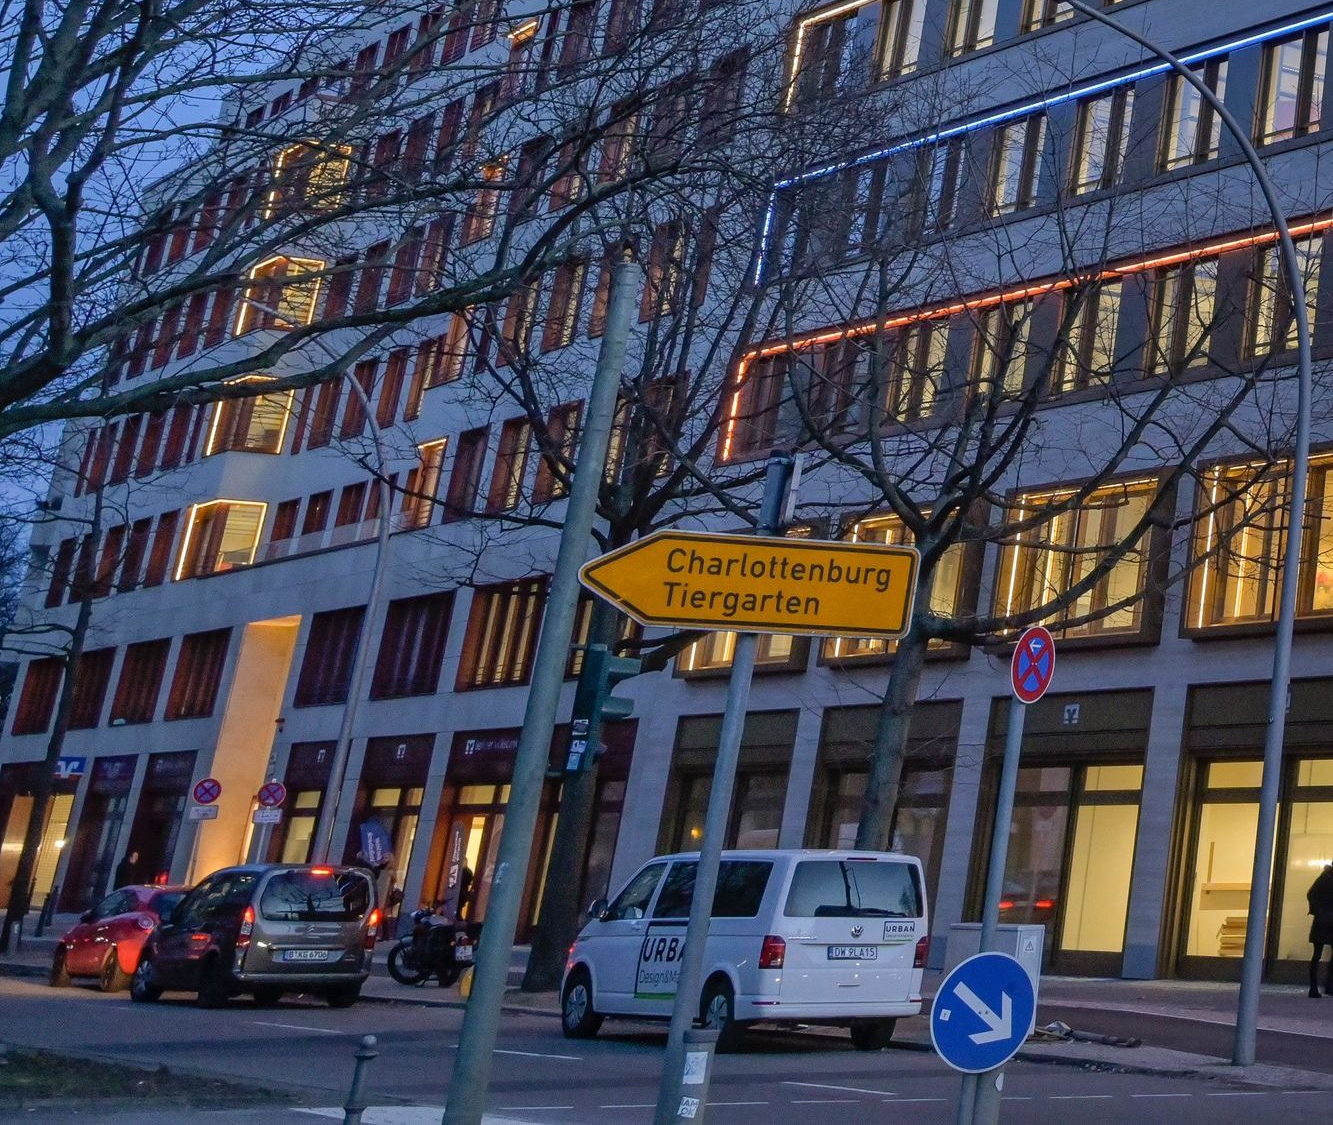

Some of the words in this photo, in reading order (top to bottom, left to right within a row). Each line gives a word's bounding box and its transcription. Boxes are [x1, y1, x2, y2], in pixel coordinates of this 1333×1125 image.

[666, 547, 892, 592] Charlottenburg
[663, 580, 820, 617] Tiergarten
[885, 924, 915, 933] URBAN
[834, 948, 847, 957] DW
[848, 947, 876, 958] 9LA15
